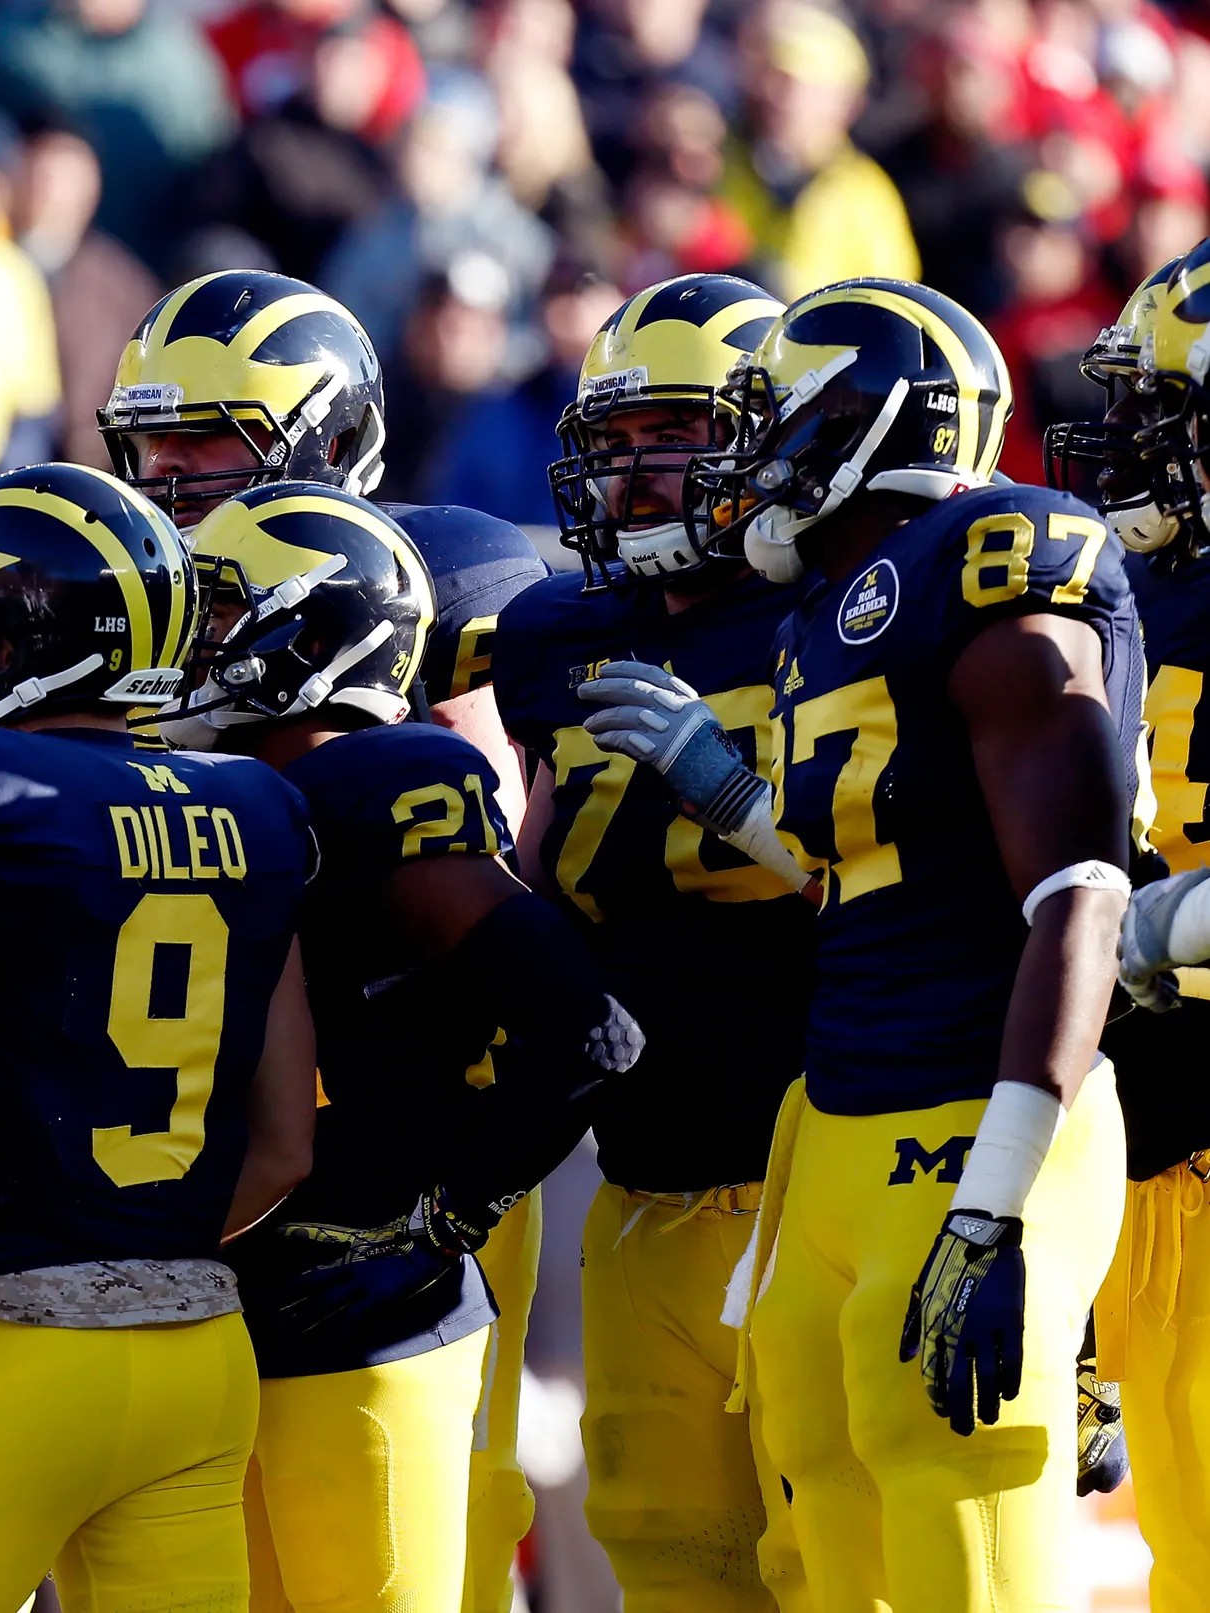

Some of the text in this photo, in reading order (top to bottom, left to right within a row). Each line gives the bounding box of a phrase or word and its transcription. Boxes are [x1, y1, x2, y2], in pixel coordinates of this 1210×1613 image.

[128, 389, 162, 400] MICHIGAN
[933, 427, 956, 455] 87
[962, 512, 1107, 608] 87
[845, 595, 888, 622] KRAMER
[857, 586, 878, 605] RON
[94, 616, 126, 632] LHS
[109, 649, 123, 671] 9
[391, 654, 410, 680] 21
[127, 761, 190, 794] M
[391, 773, 500, 857] 21
[109, 806, 247, 881] DILEO
[92, 894, 230, 1187] 9
[424, 1196, 441, 1247] PRIVILEGE
